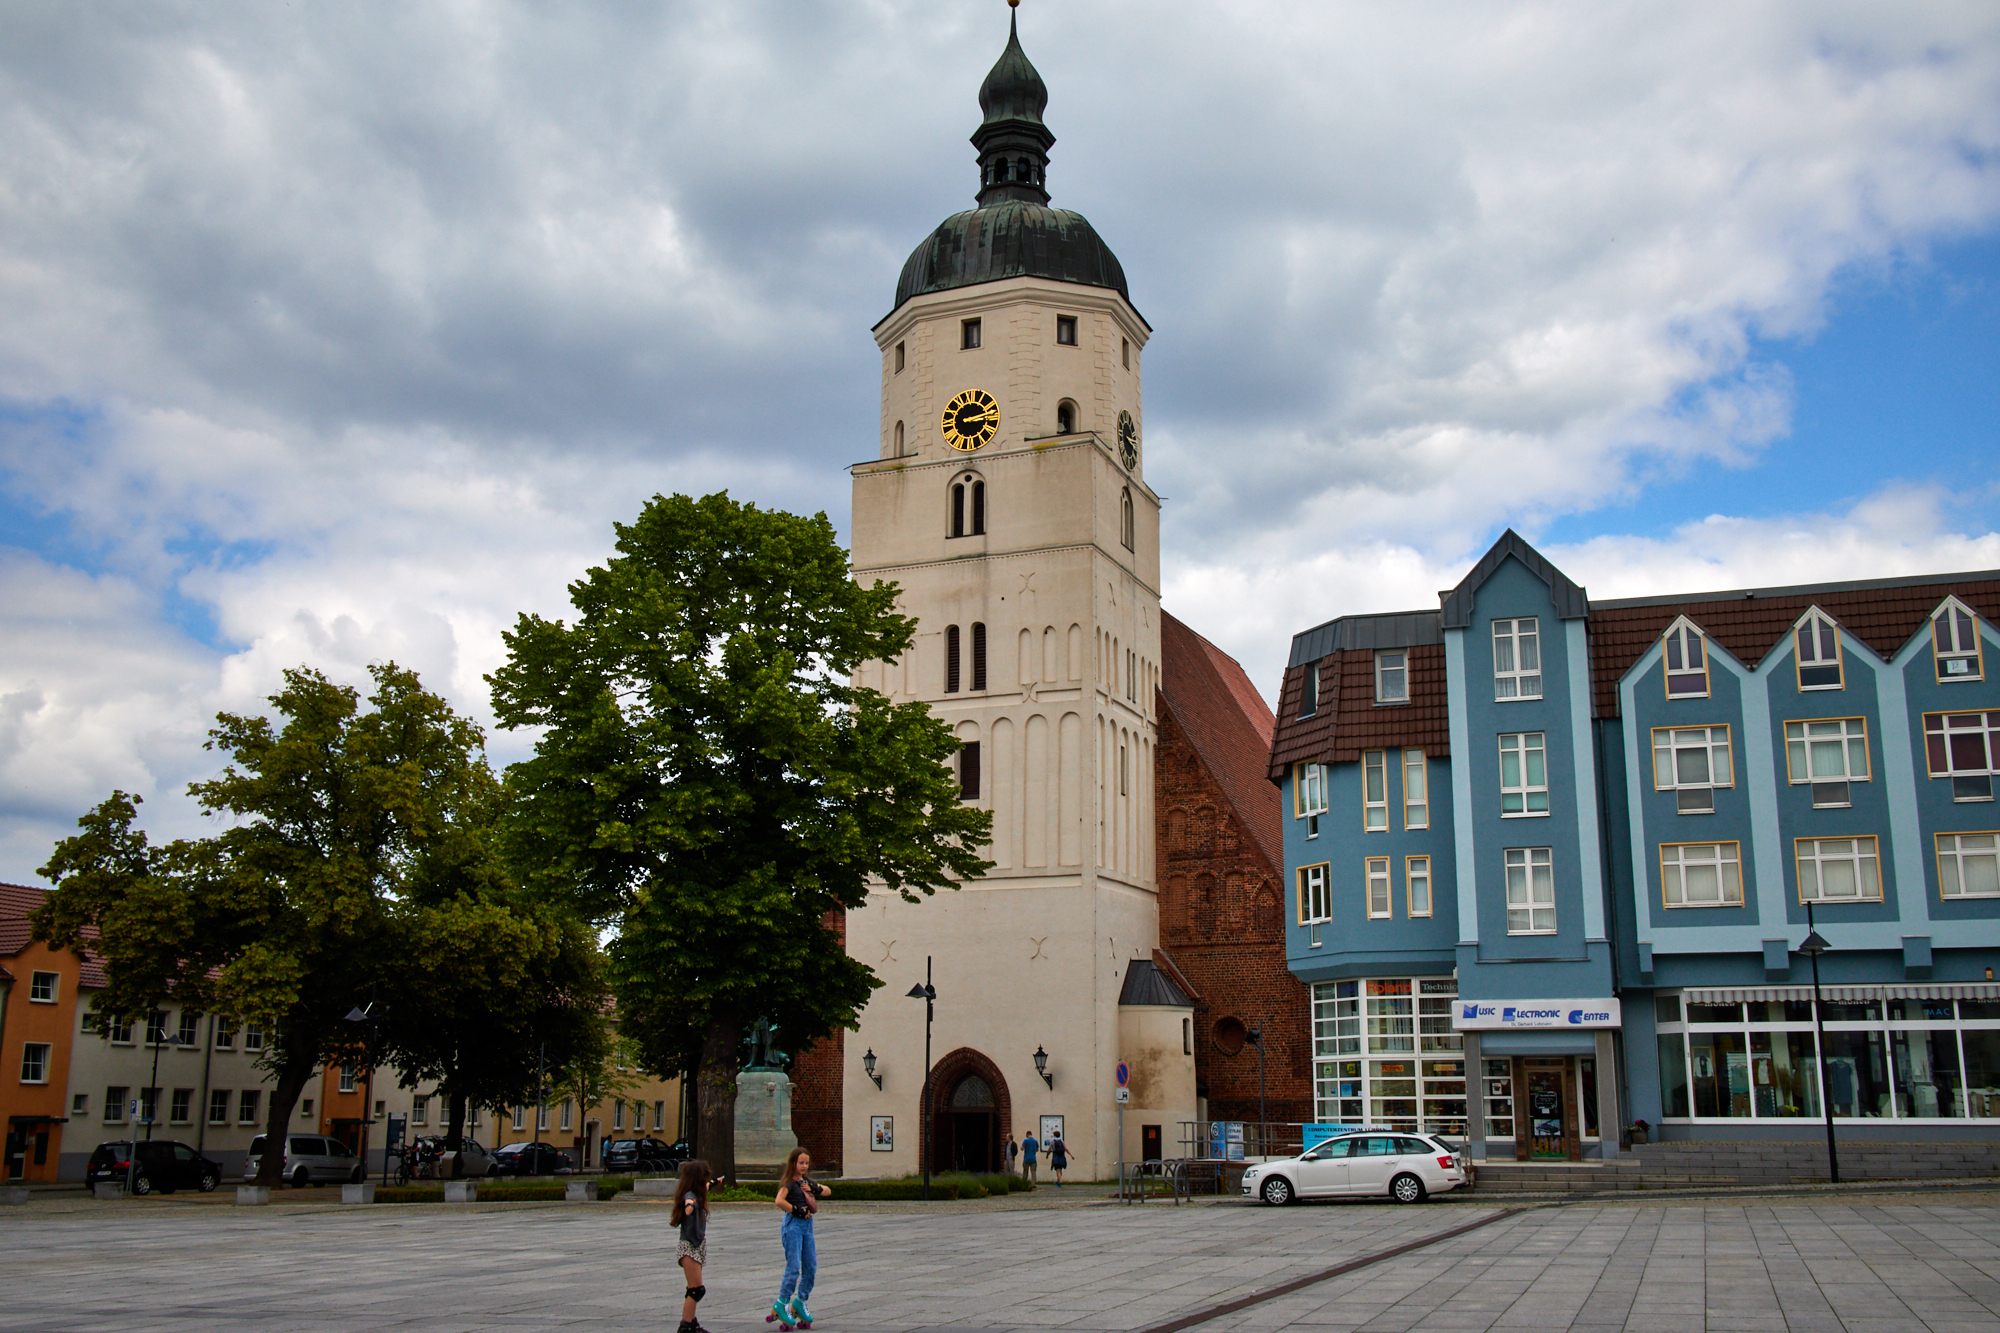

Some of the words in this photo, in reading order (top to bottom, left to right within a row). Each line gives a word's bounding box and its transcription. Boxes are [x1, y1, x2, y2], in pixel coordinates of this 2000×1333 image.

[1366, 982, 1412, 993] Roland
[1463, 1003, 1496, 1019] MUSIC
[1502, 1007, 1561, 1022] ELECTRONIC
[1568, 1009, 1610, 1024] CENTER
[1926, 1007, 1950, 1016] MAC
